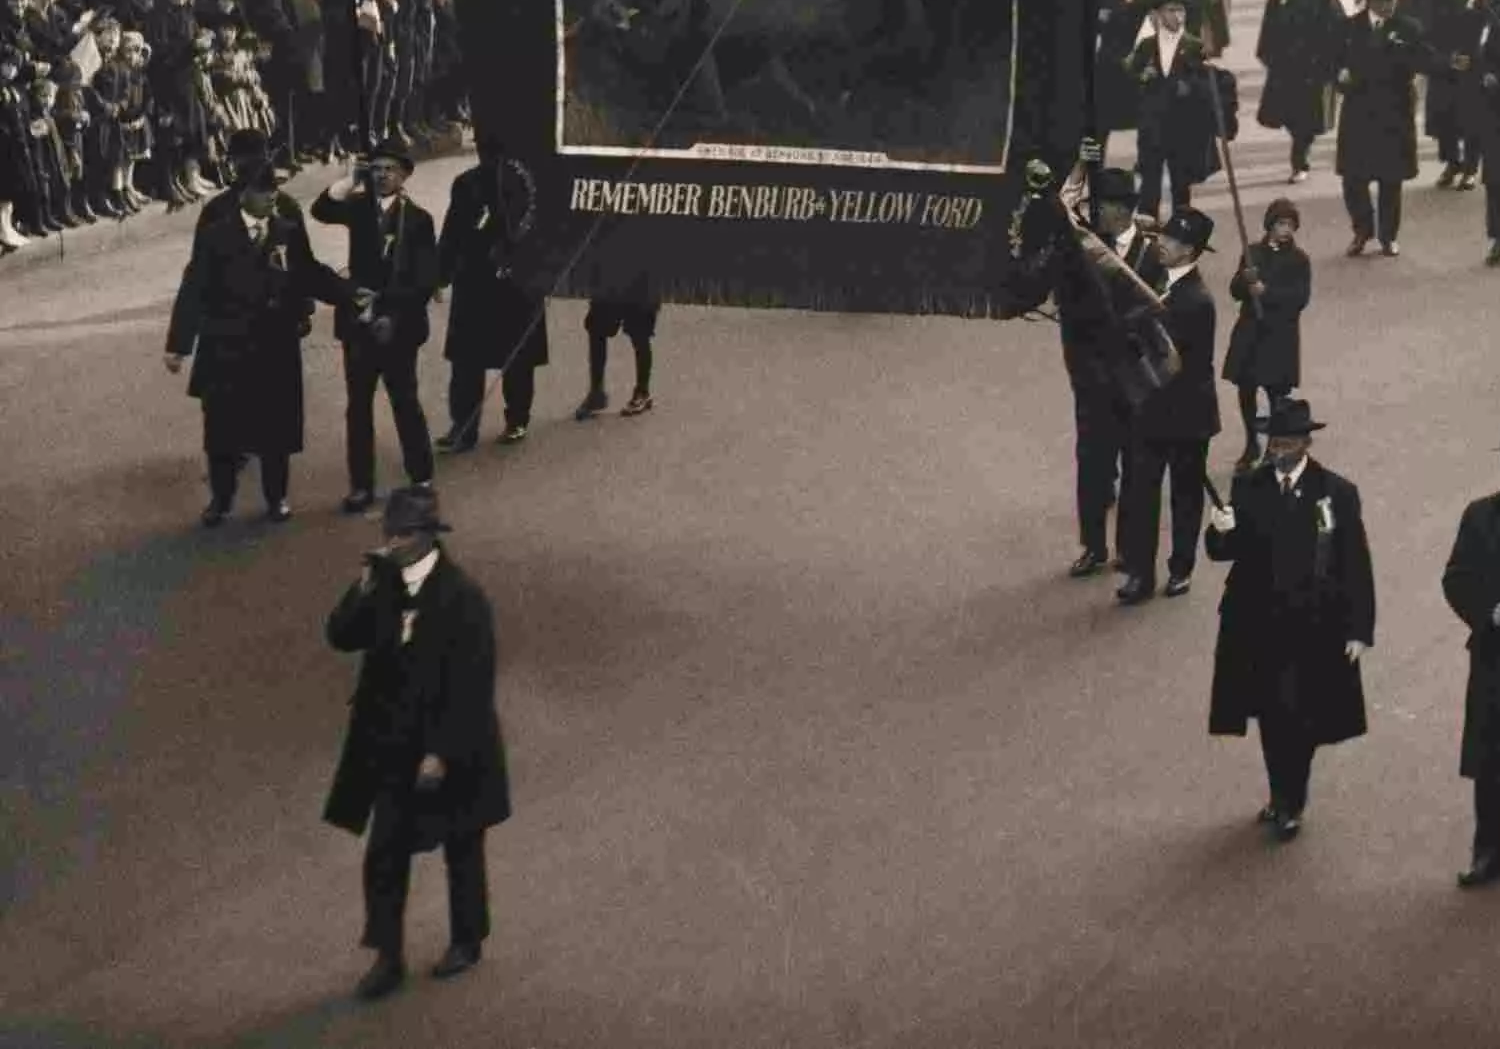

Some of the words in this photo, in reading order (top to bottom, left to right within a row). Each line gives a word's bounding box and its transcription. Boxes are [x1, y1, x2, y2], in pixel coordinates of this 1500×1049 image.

[570, 178, 702, 216] REMEMBER
[707, 184, 817, 221] BENBURB
[829, 189, 920, 223] YELLOW
[920, 194, 983, 228] FORD
